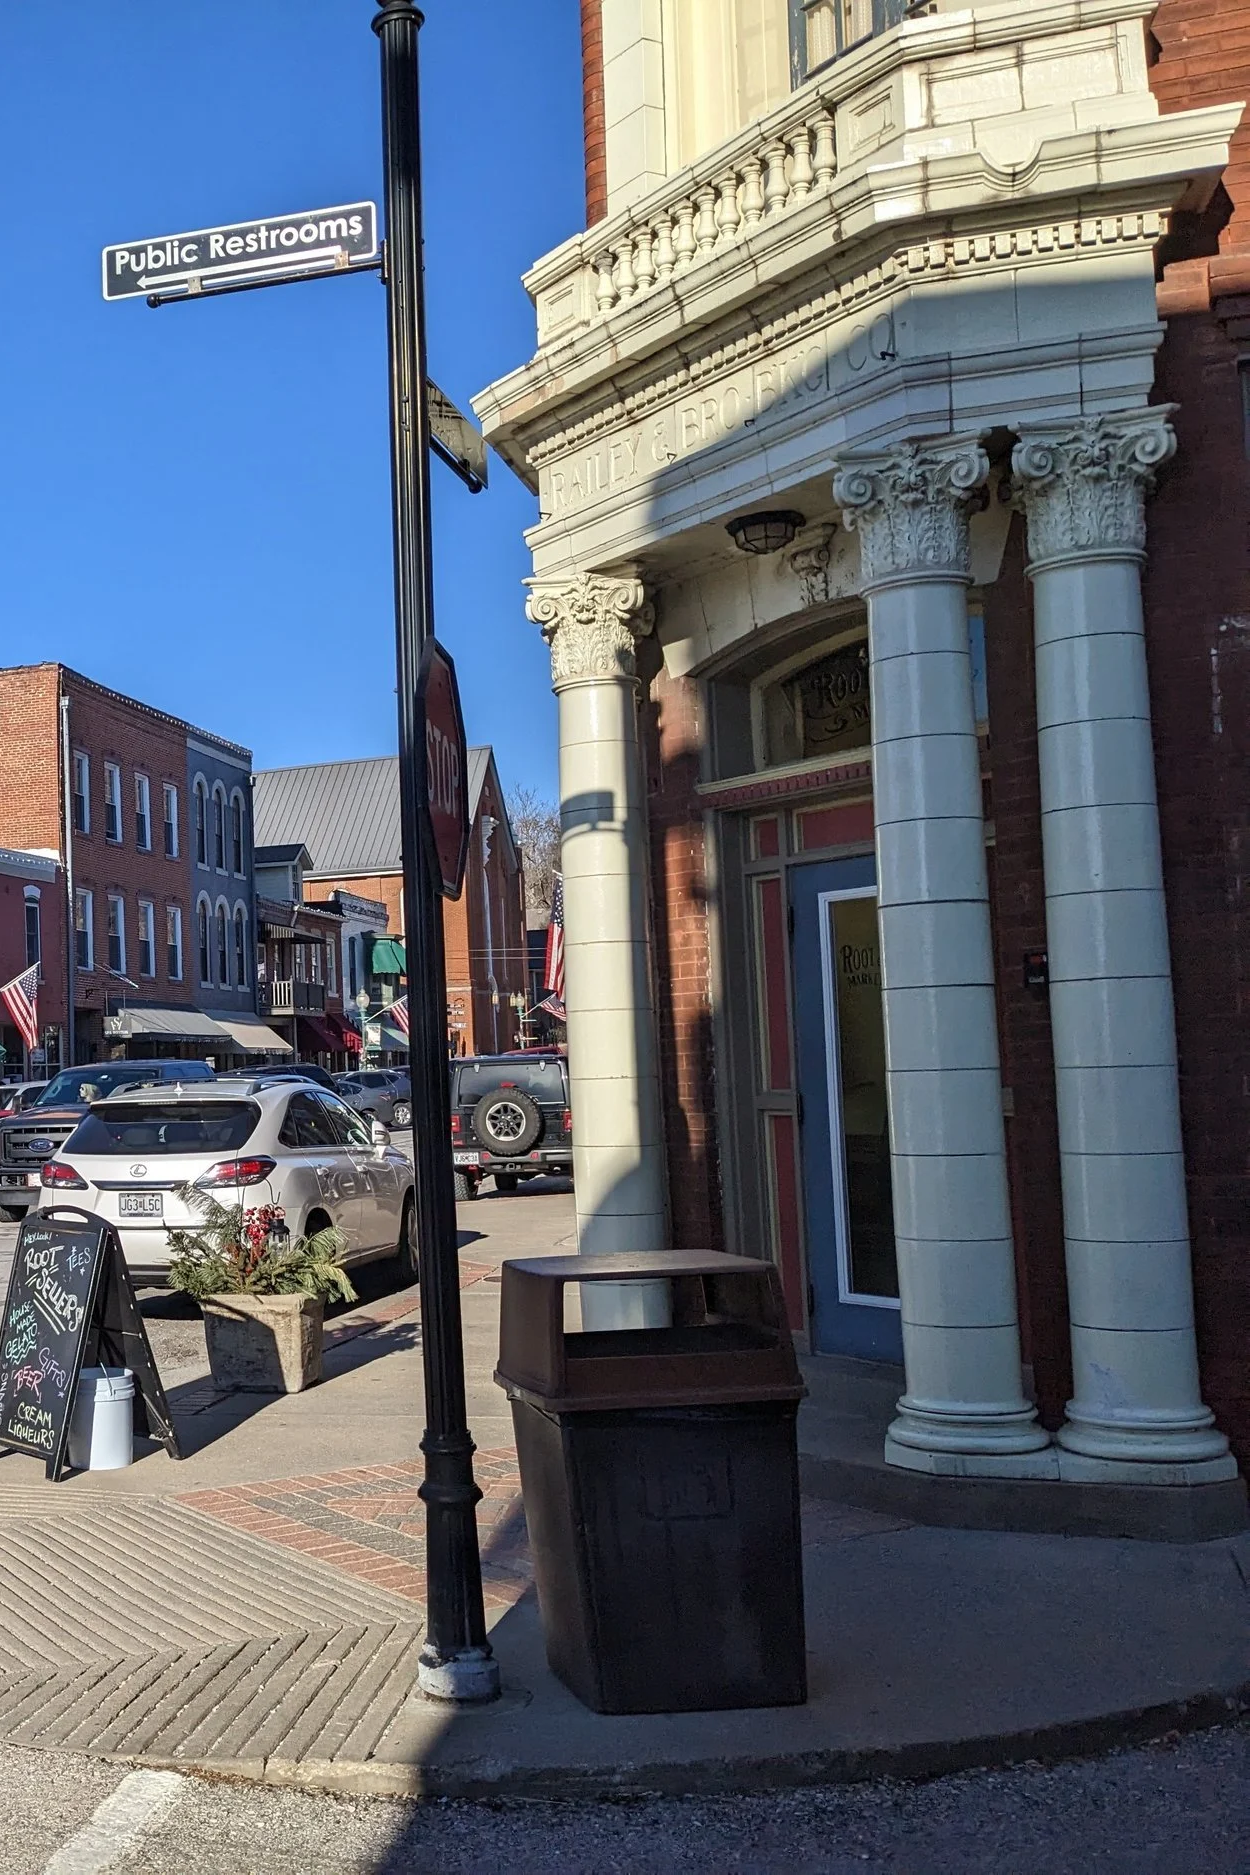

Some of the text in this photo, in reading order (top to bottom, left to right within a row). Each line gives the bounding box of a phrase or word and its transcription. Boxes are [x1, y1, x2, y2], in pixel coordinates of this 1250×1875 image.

[116, 214, 363, 275] Public Restrooms
[552, 432, 643, 511] RAILEY
[652, 420, 669, 462] &
[425, 718, 460, 820] STOP
[121, 1198, 161, 1211] JG3 L5C
[24, 1245, 65, 1276] ROOT
[66, 1247, 91, 1272] TEES
[5, 1323, 38, 1359] GELATO
[13, 1366, 44, 1397] BEER
[17, 1401, 53, 1429] CREAM
